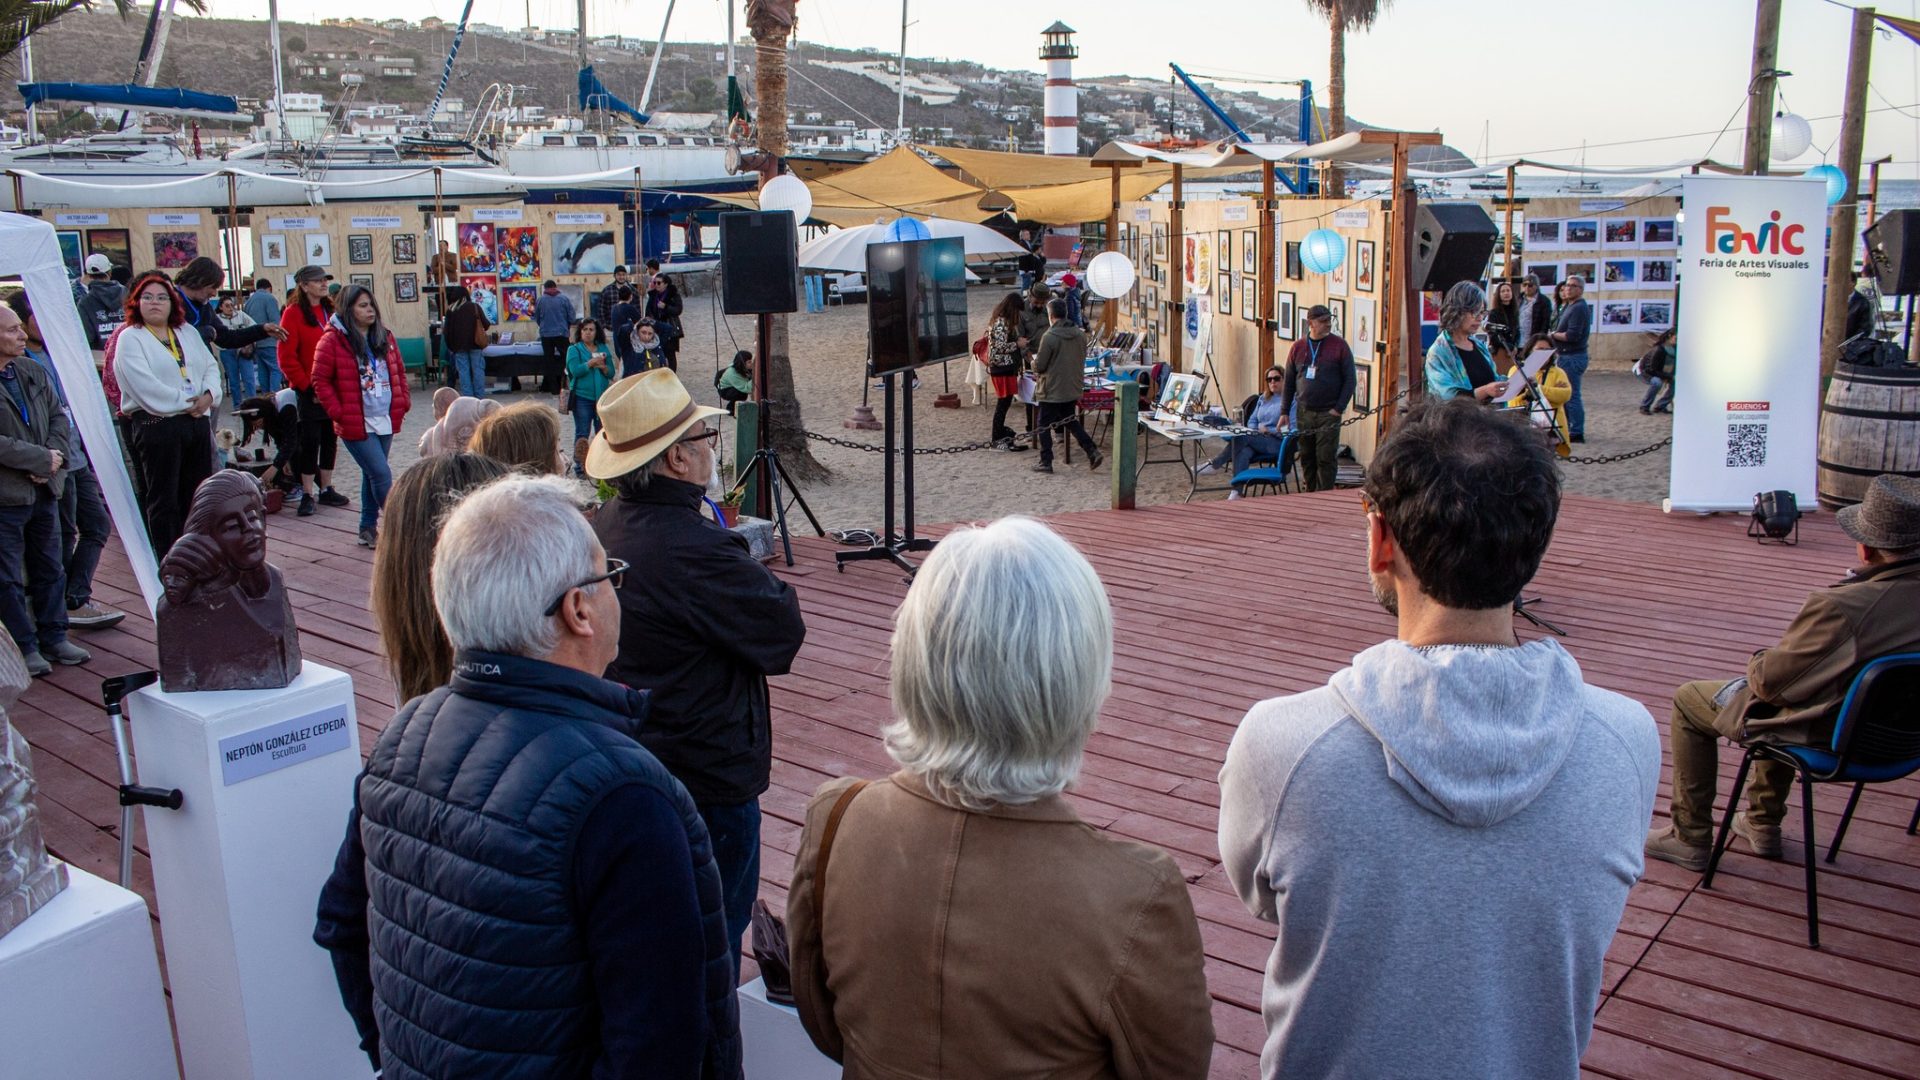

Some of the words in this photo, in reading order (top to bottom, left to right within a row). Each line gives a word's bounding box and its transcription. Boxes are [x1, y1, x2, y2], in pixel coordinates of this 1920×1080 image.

[1705, 206, 1805, 255] Favic
[1699, 258, 1724, 268] Feria
[1726, 259, 1737, 268] de
[1739, 259, 1766, 269] Artes
[1768, 259, 1809, 269] Visuales
[1735, 270, 1772, 278] Coquimbo
[225, 742, 264, 762] NEPTÓN
[265, 727, 312, 751] GONZÁLEZ
[312, 717, 347, 737] CEPEDA
[271, 743, 307, 760] Escultura
